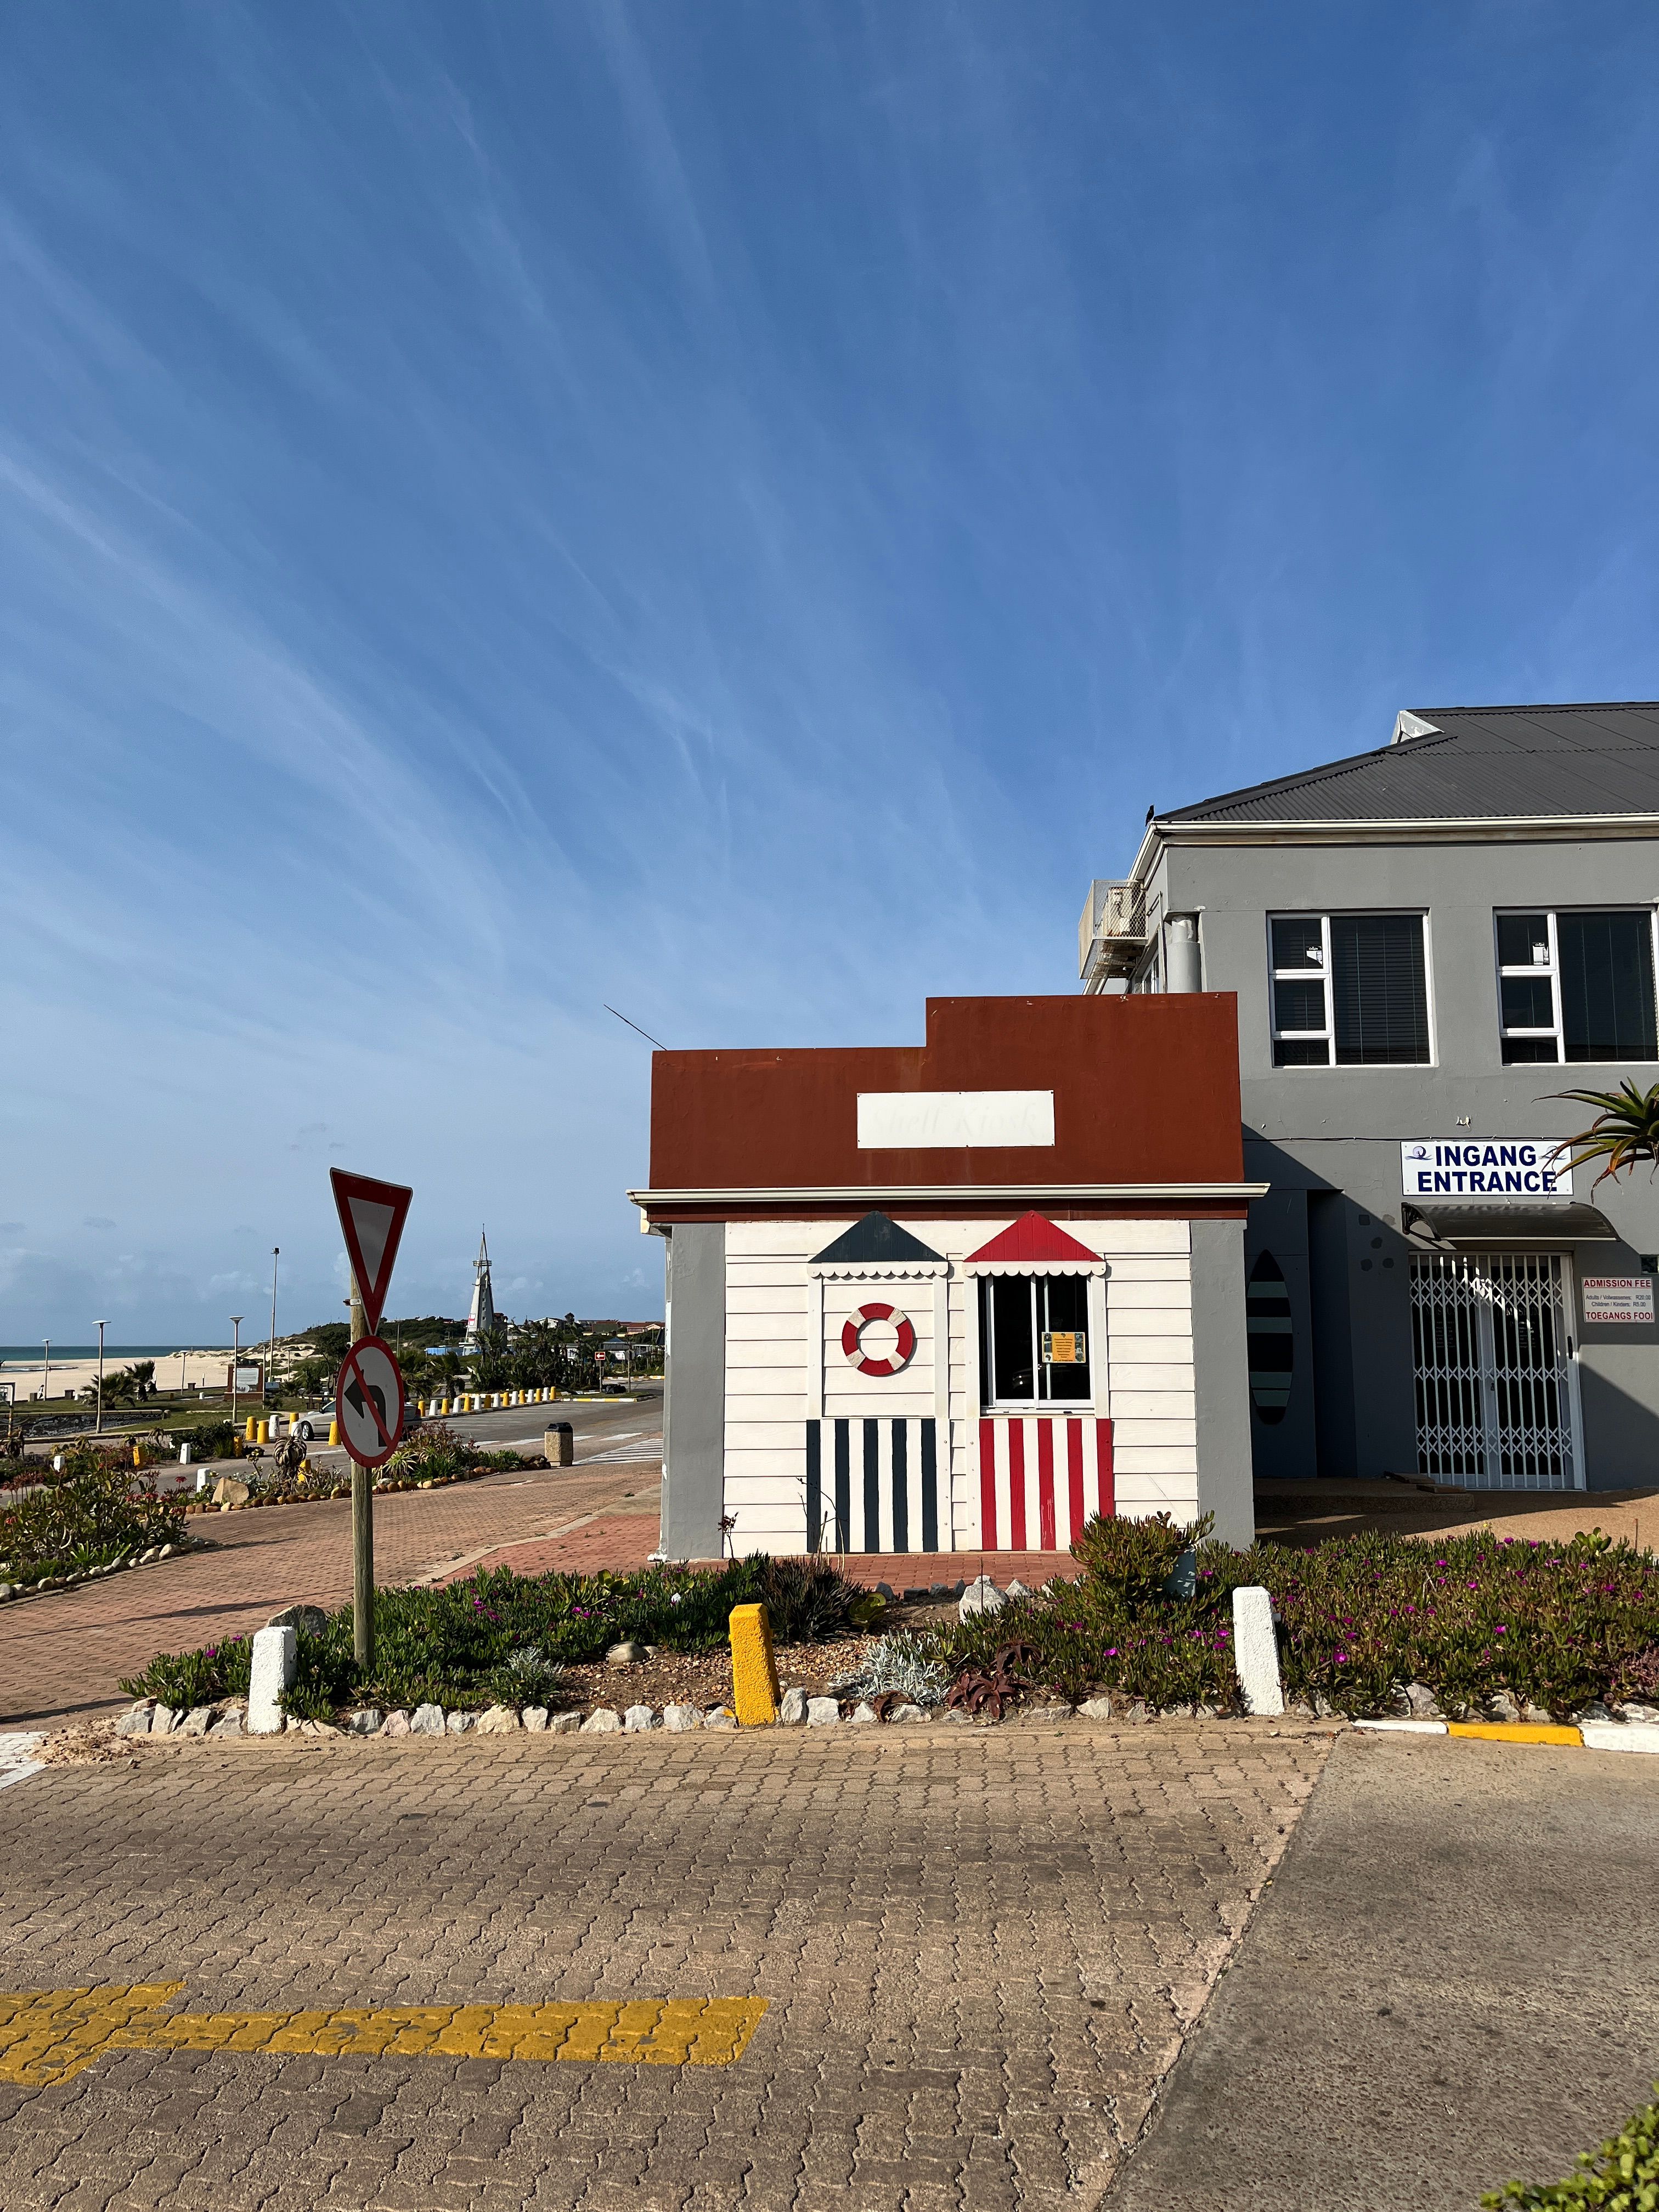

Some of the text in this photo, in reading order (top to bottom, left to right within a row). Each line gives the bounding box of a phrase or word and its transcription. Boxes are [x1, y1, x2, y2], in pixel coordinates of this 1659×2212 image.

[1435, 1146, 1537, 1166] INGANG
[1418, 1171, 1558, 1192] ENTRANCE
[1634, 1312, 1653, 1320] FOOI
